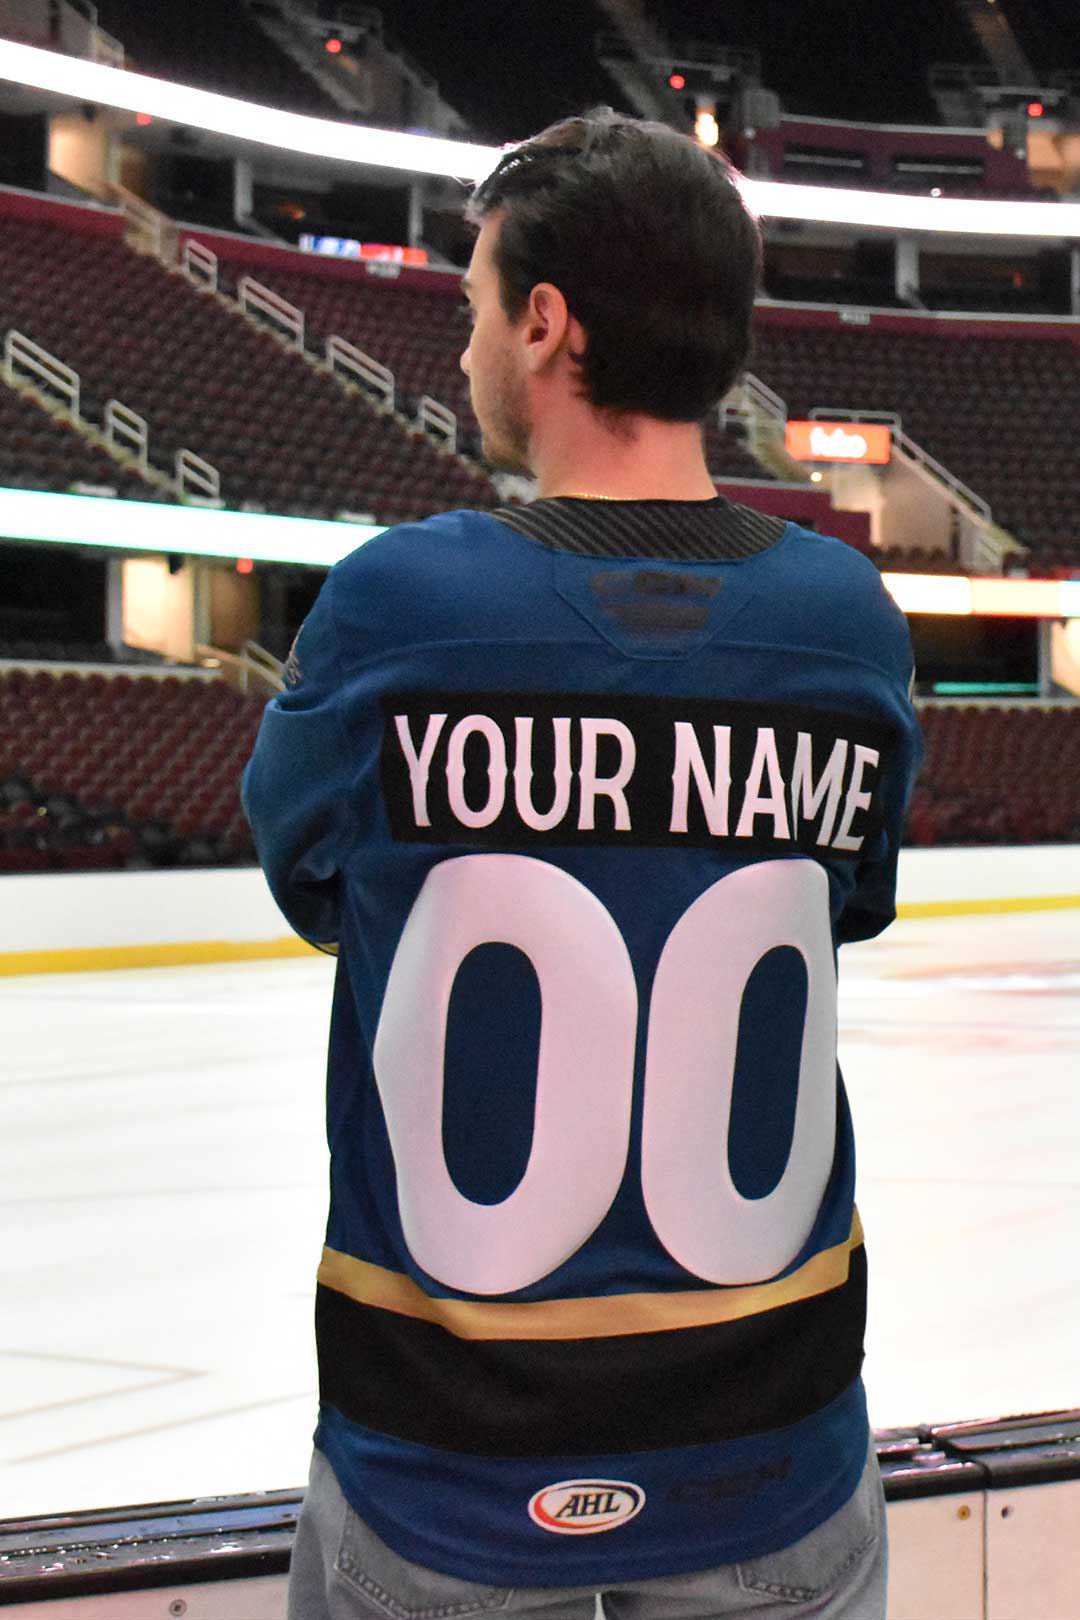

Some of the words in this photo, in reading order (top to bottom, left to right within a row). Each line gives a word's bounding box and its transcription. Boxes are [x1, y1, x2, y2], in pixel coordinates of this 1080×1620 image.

[394, 713, 636, 831] YOUR
[670, 721, 880, 851] NAME
[372, 854, 838, 1295] 00
[555, 1492, 621, 1518] AHL
